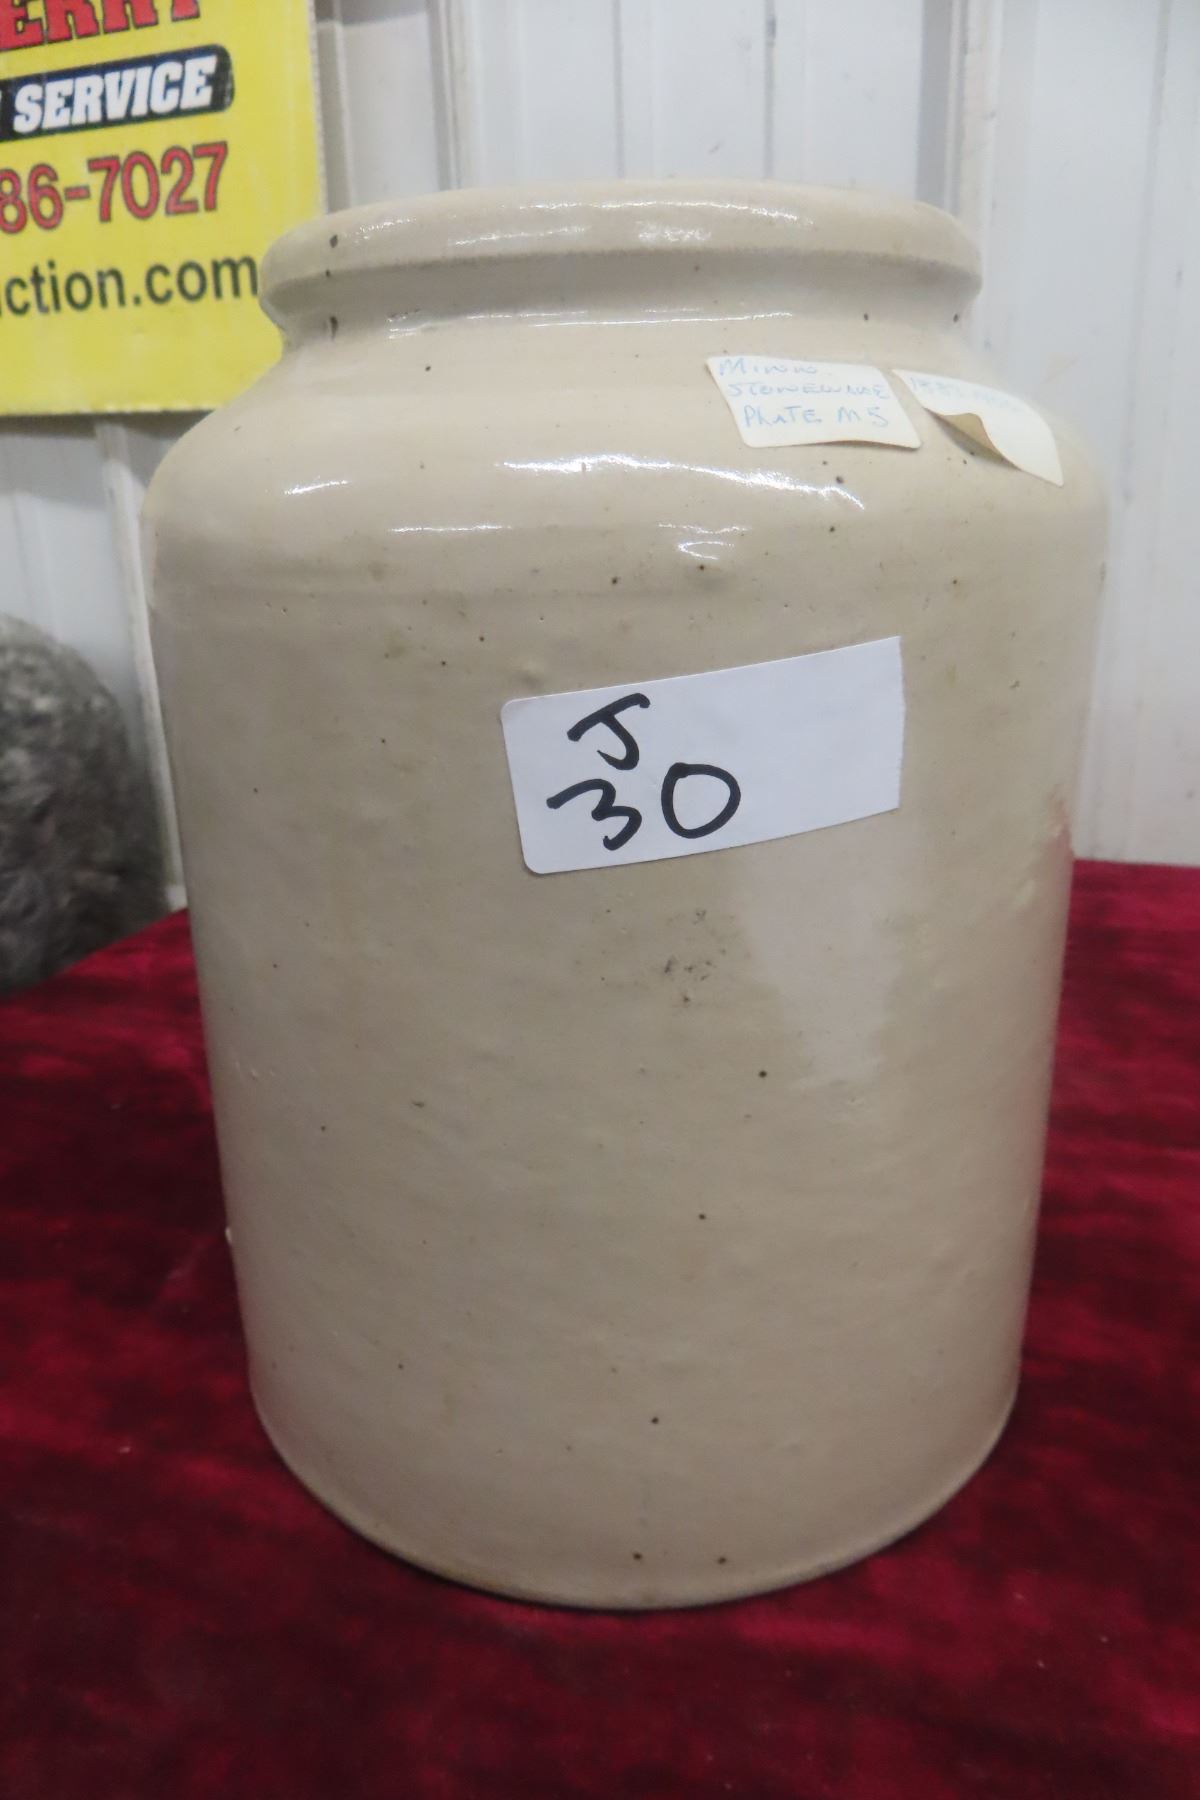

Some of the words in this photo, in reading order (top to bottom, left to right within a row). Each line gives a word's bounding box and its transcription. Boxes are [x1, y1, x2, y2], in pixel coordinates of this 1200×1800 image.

[13, 55, 217, 134] SERVICE
[0, 141, 228, 235] 86-7027
[0, 255, 258, 317] ction.com
[566, 692, 651, 771] J
[546, 762, 742, 852] 30
